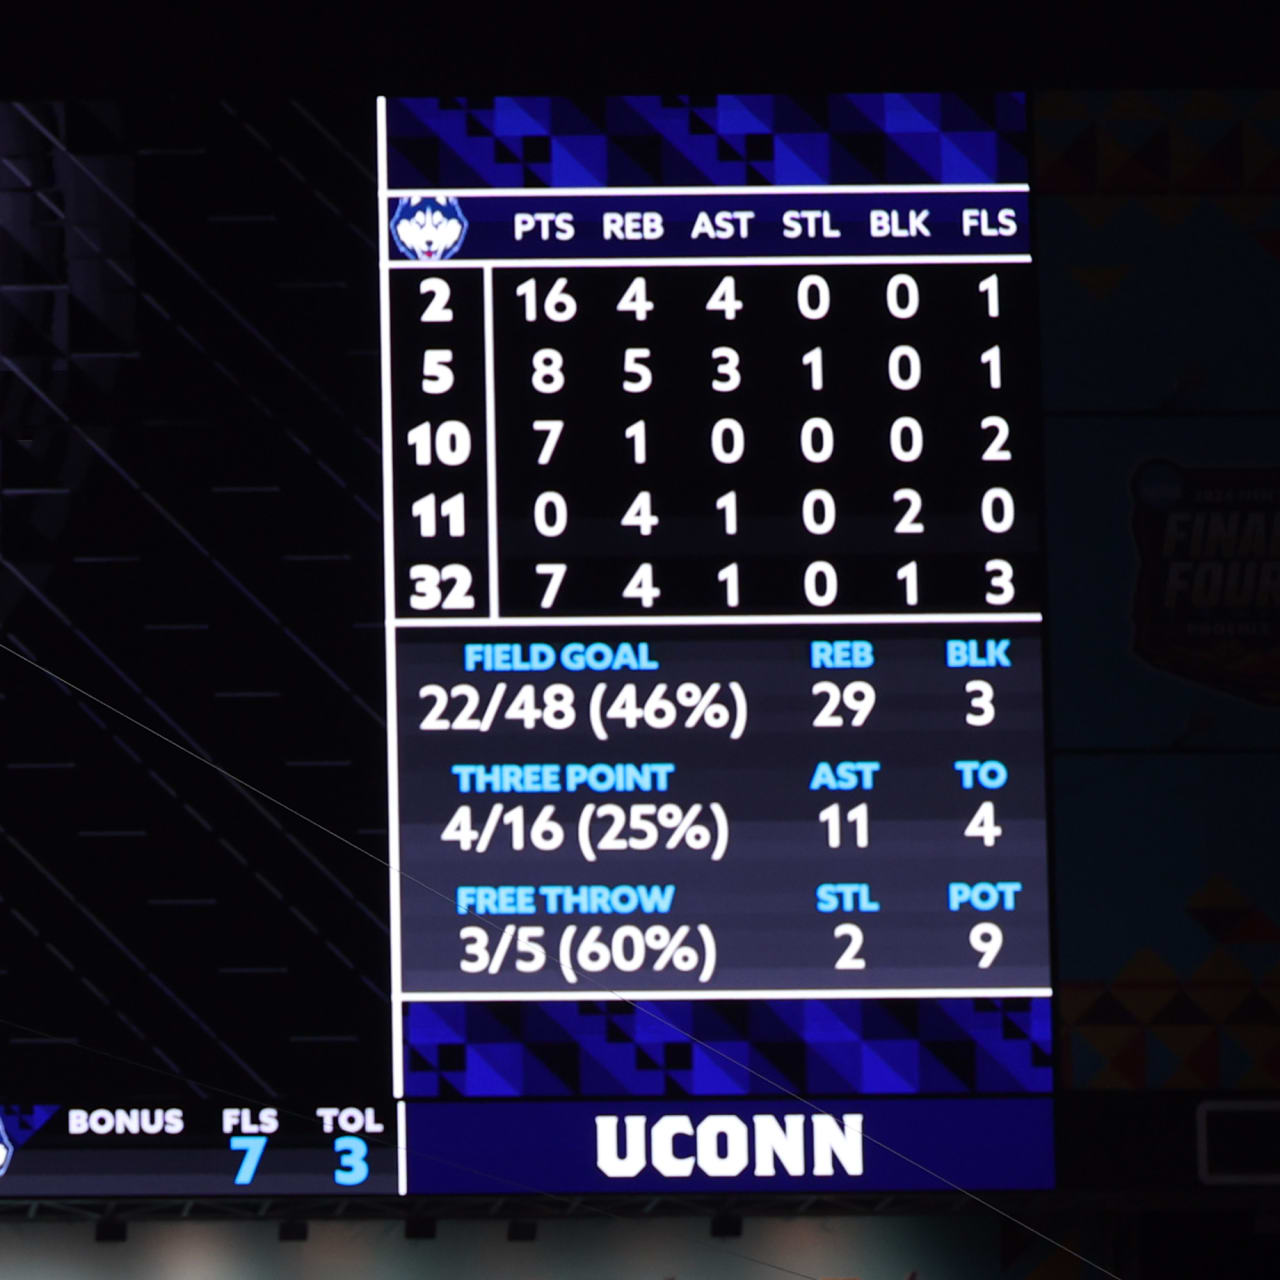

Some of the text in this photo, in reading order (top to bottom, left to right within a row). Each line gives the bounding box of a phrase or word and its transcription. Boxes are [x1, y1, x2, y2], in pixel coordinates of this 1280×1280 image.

[514, 208, 1018, 241] PTS REB AST STL BLK FLS
[419, 273, 999, 323] 2 16 4 4 0 0 1
[464, 639, 1012, 672] FIELD GOAL REB BLK
[418, 679, 995, 741] 22/48 (46%) 29 3
[450, 760, 1008, 794] THREE POINT AST TO
[440, 801, 1003, 862] 4/16 (25%) 11 4
[455, 881, 1023, 916] FREE THROW STL POT
[459, 922, 1003, 985] 3/5 (60%) 2 9
[68, 1107, 384, 1135] BONUS FLS TOL
[594, 1113, 864, 1178] UCONN
[229, 1135, 370, 1187] 7 3
